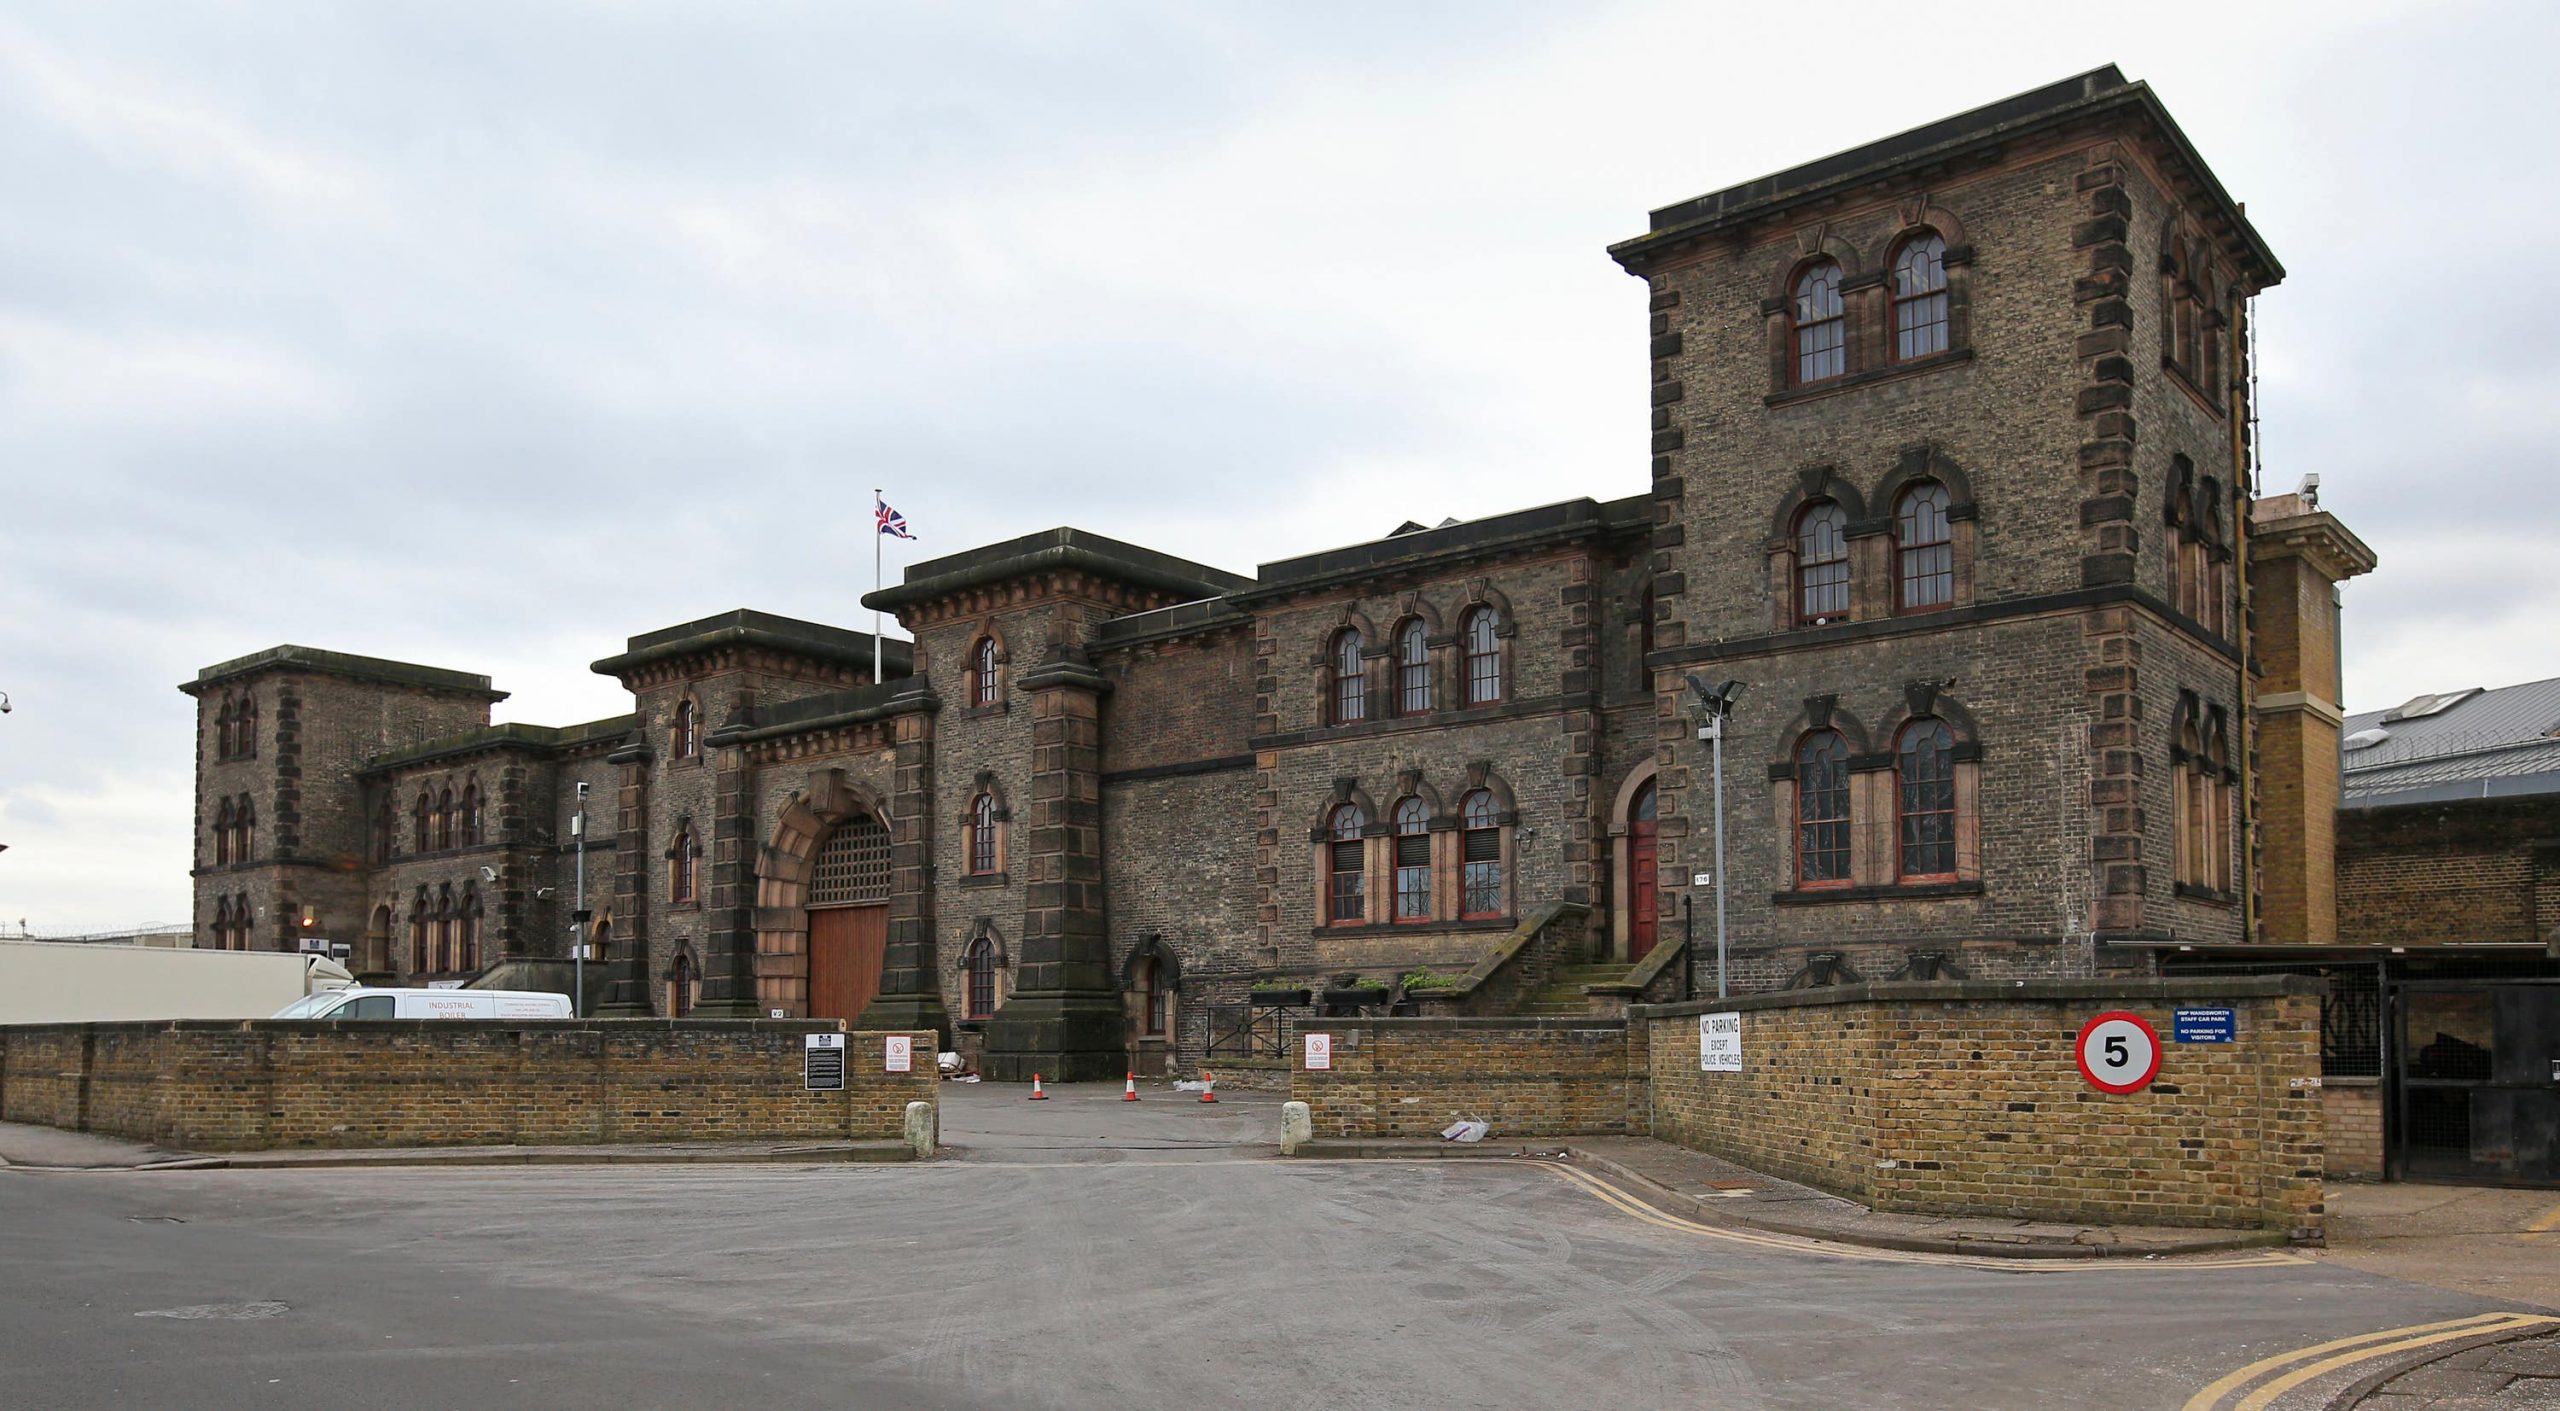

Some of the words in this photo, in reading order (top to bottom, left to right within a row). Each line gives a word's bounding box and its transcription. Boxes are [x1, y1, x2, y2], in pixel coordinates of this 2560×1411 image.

[1702, 1020, 1709, 1034] NO
[1712, 1018, 1738, 1034] PARKING
[1711, 1040, 1728, 1050] EXCEPT
[2105, 1036, 2128, 1067] 5
[1702, 1054, 1716, 1065] POLICE
[1719, 1054, 1740, 1065] VEHICLES
